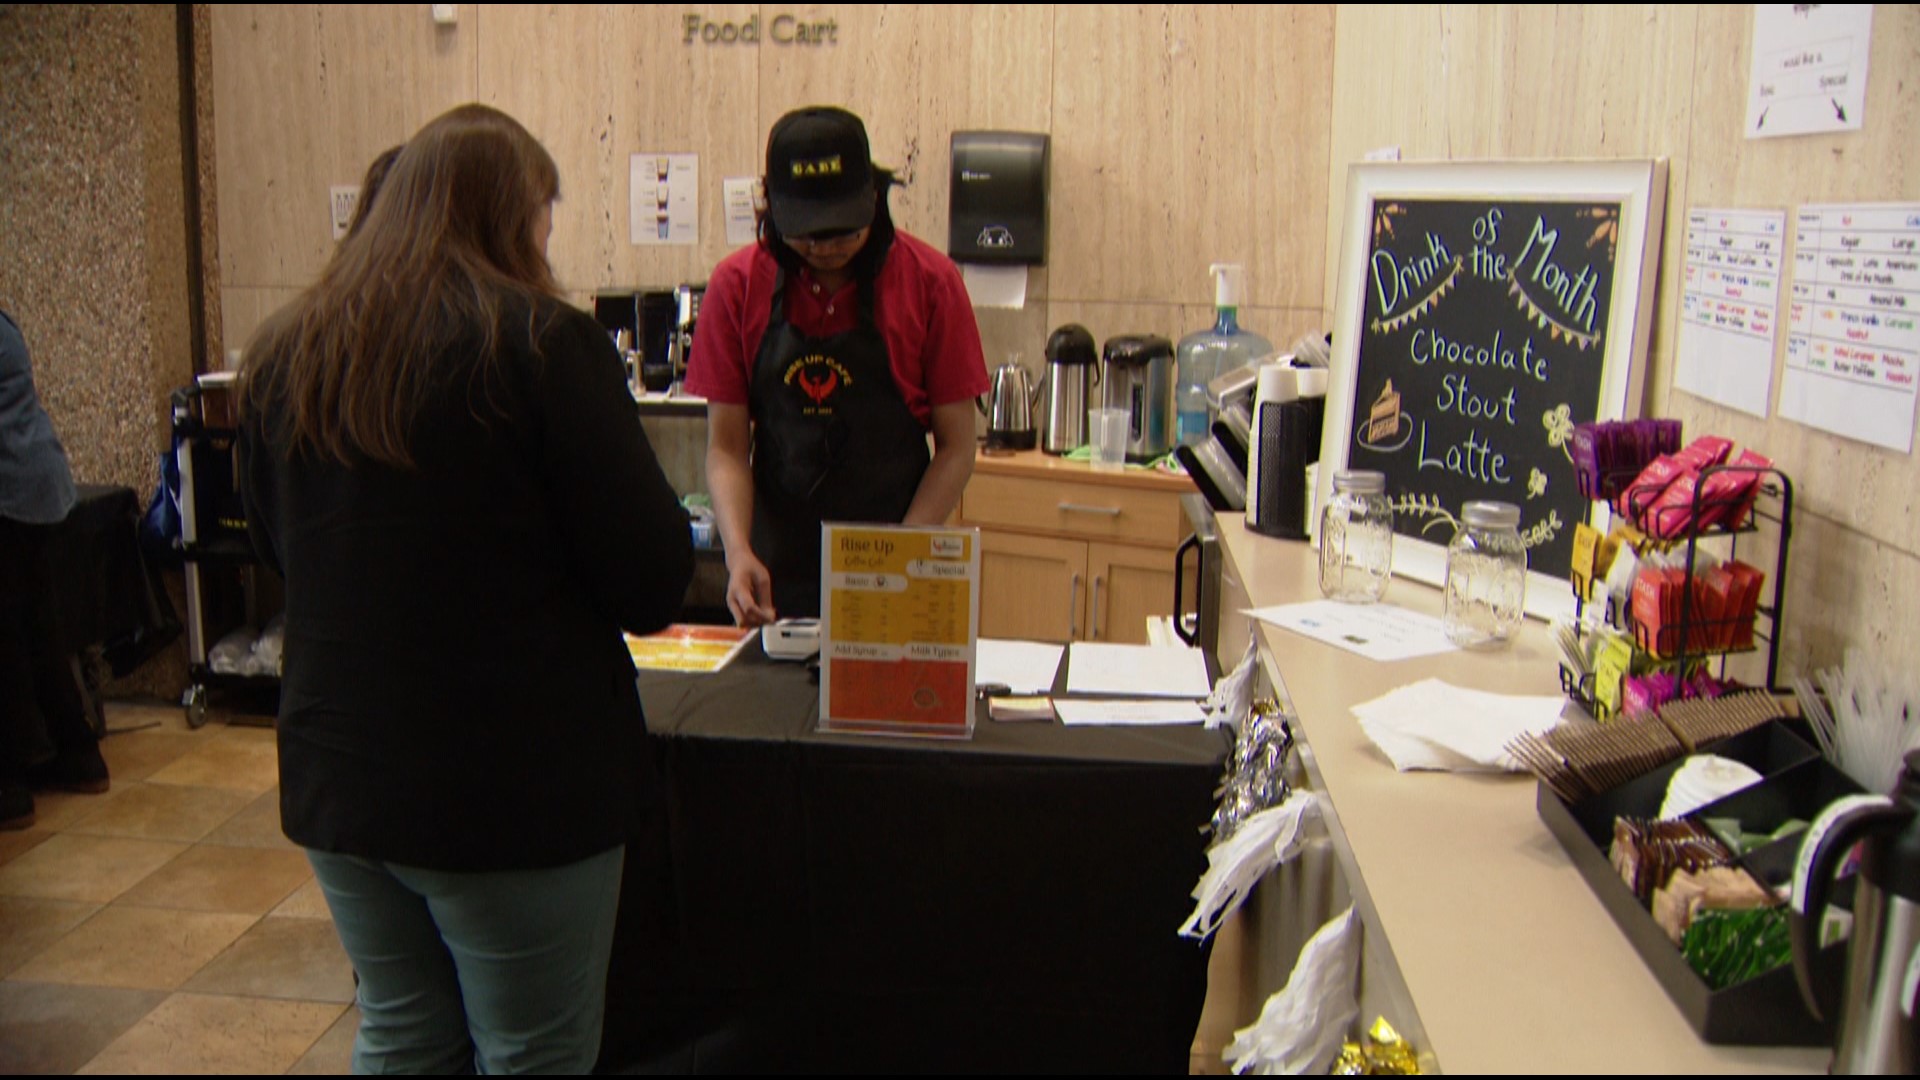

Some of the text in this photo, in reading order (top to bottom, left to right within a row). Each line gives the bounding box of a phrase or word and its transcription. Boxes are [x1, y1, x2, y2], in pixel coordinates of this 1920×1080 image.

[682, 14, 838, 43] Food Cart
[1371, 207, 1599, 333] Drink of the Month
[1410, 328, 1548, 382] Chocolate
[1436, 374, 1517, 425] Stout
[1417, 419, 1512, 484] Latte
[841, 536, 894, 557] Rise Up
[932, 564, 966, 577] Special
[911, 646, 960, 658] Milk Types
